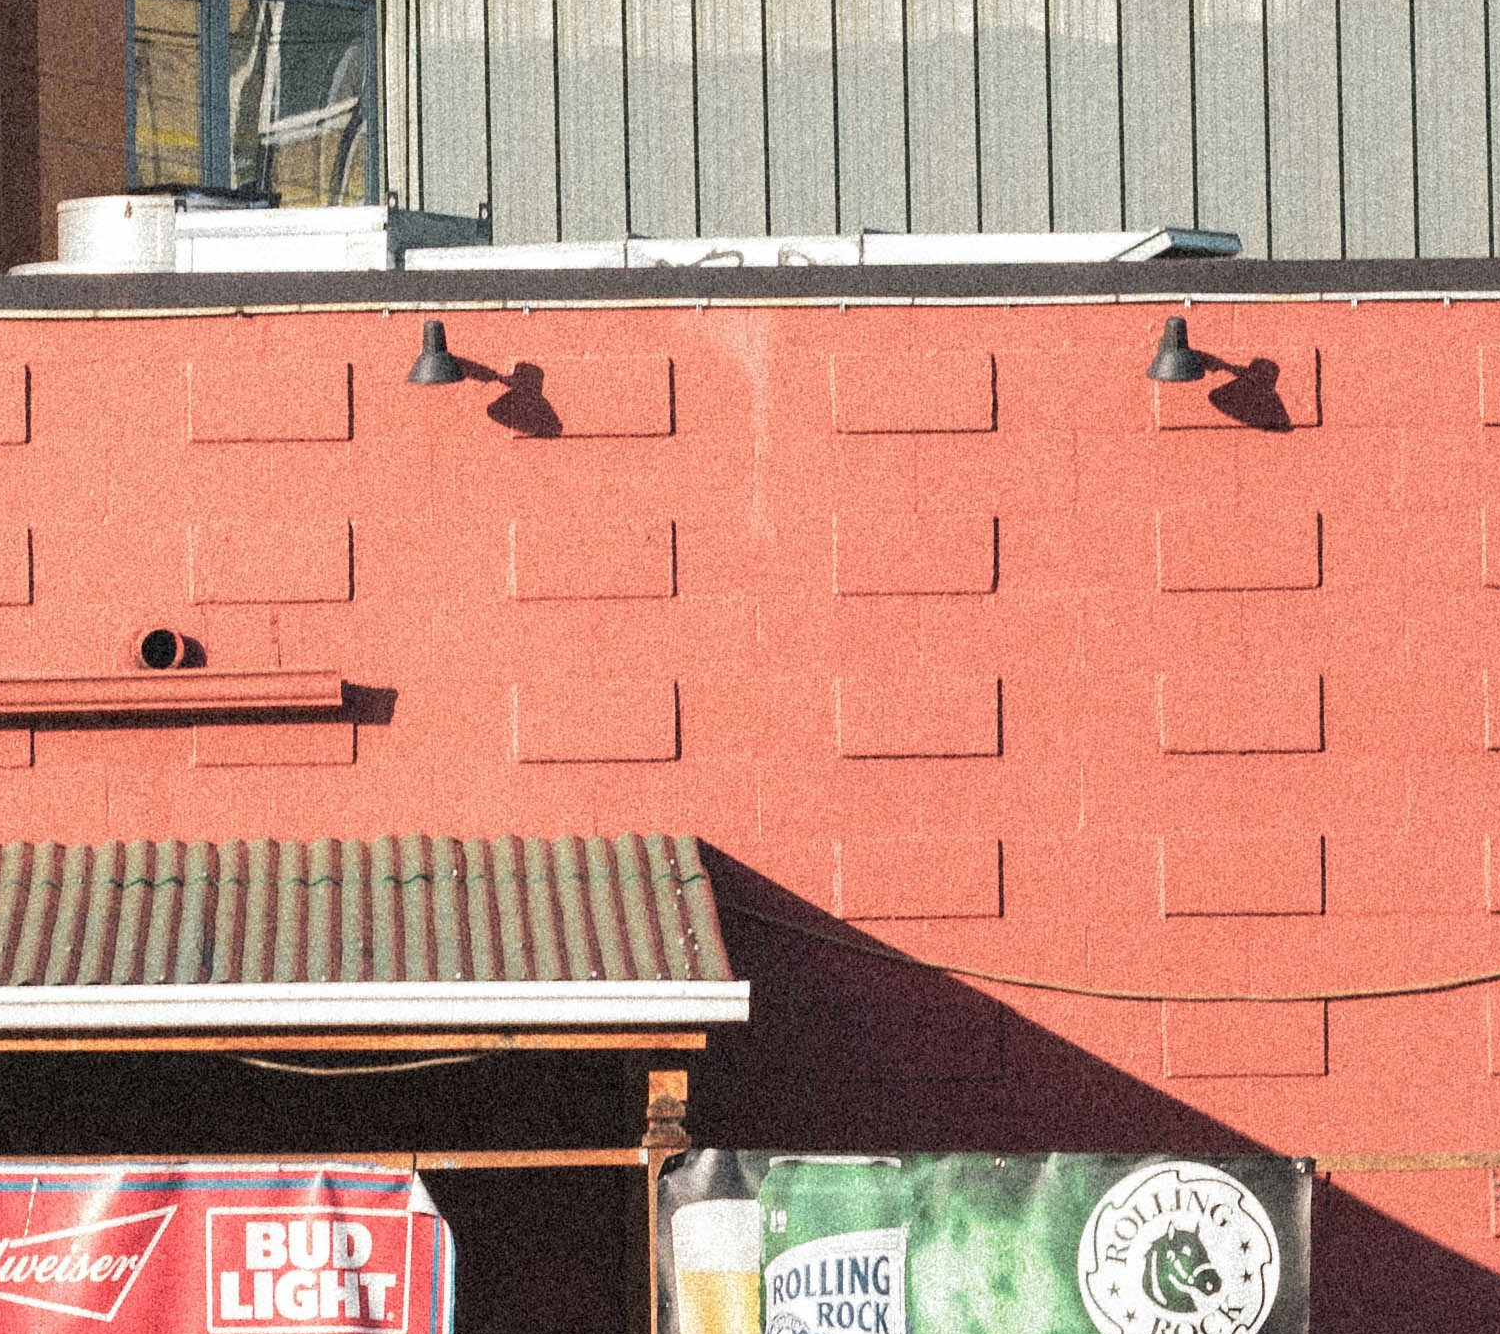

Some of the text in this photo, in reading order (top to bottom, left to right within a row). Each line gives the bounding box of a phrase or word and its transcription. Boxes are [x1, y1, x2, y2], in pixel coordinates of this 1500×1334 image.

[246, 1220, 371, 1269] BUD
[1105, 1188, 1233, 1265] ROLLING
[220, 1272, 396, 1322] LIGHT
[774, 1256, 890, 1305] ROLLING
